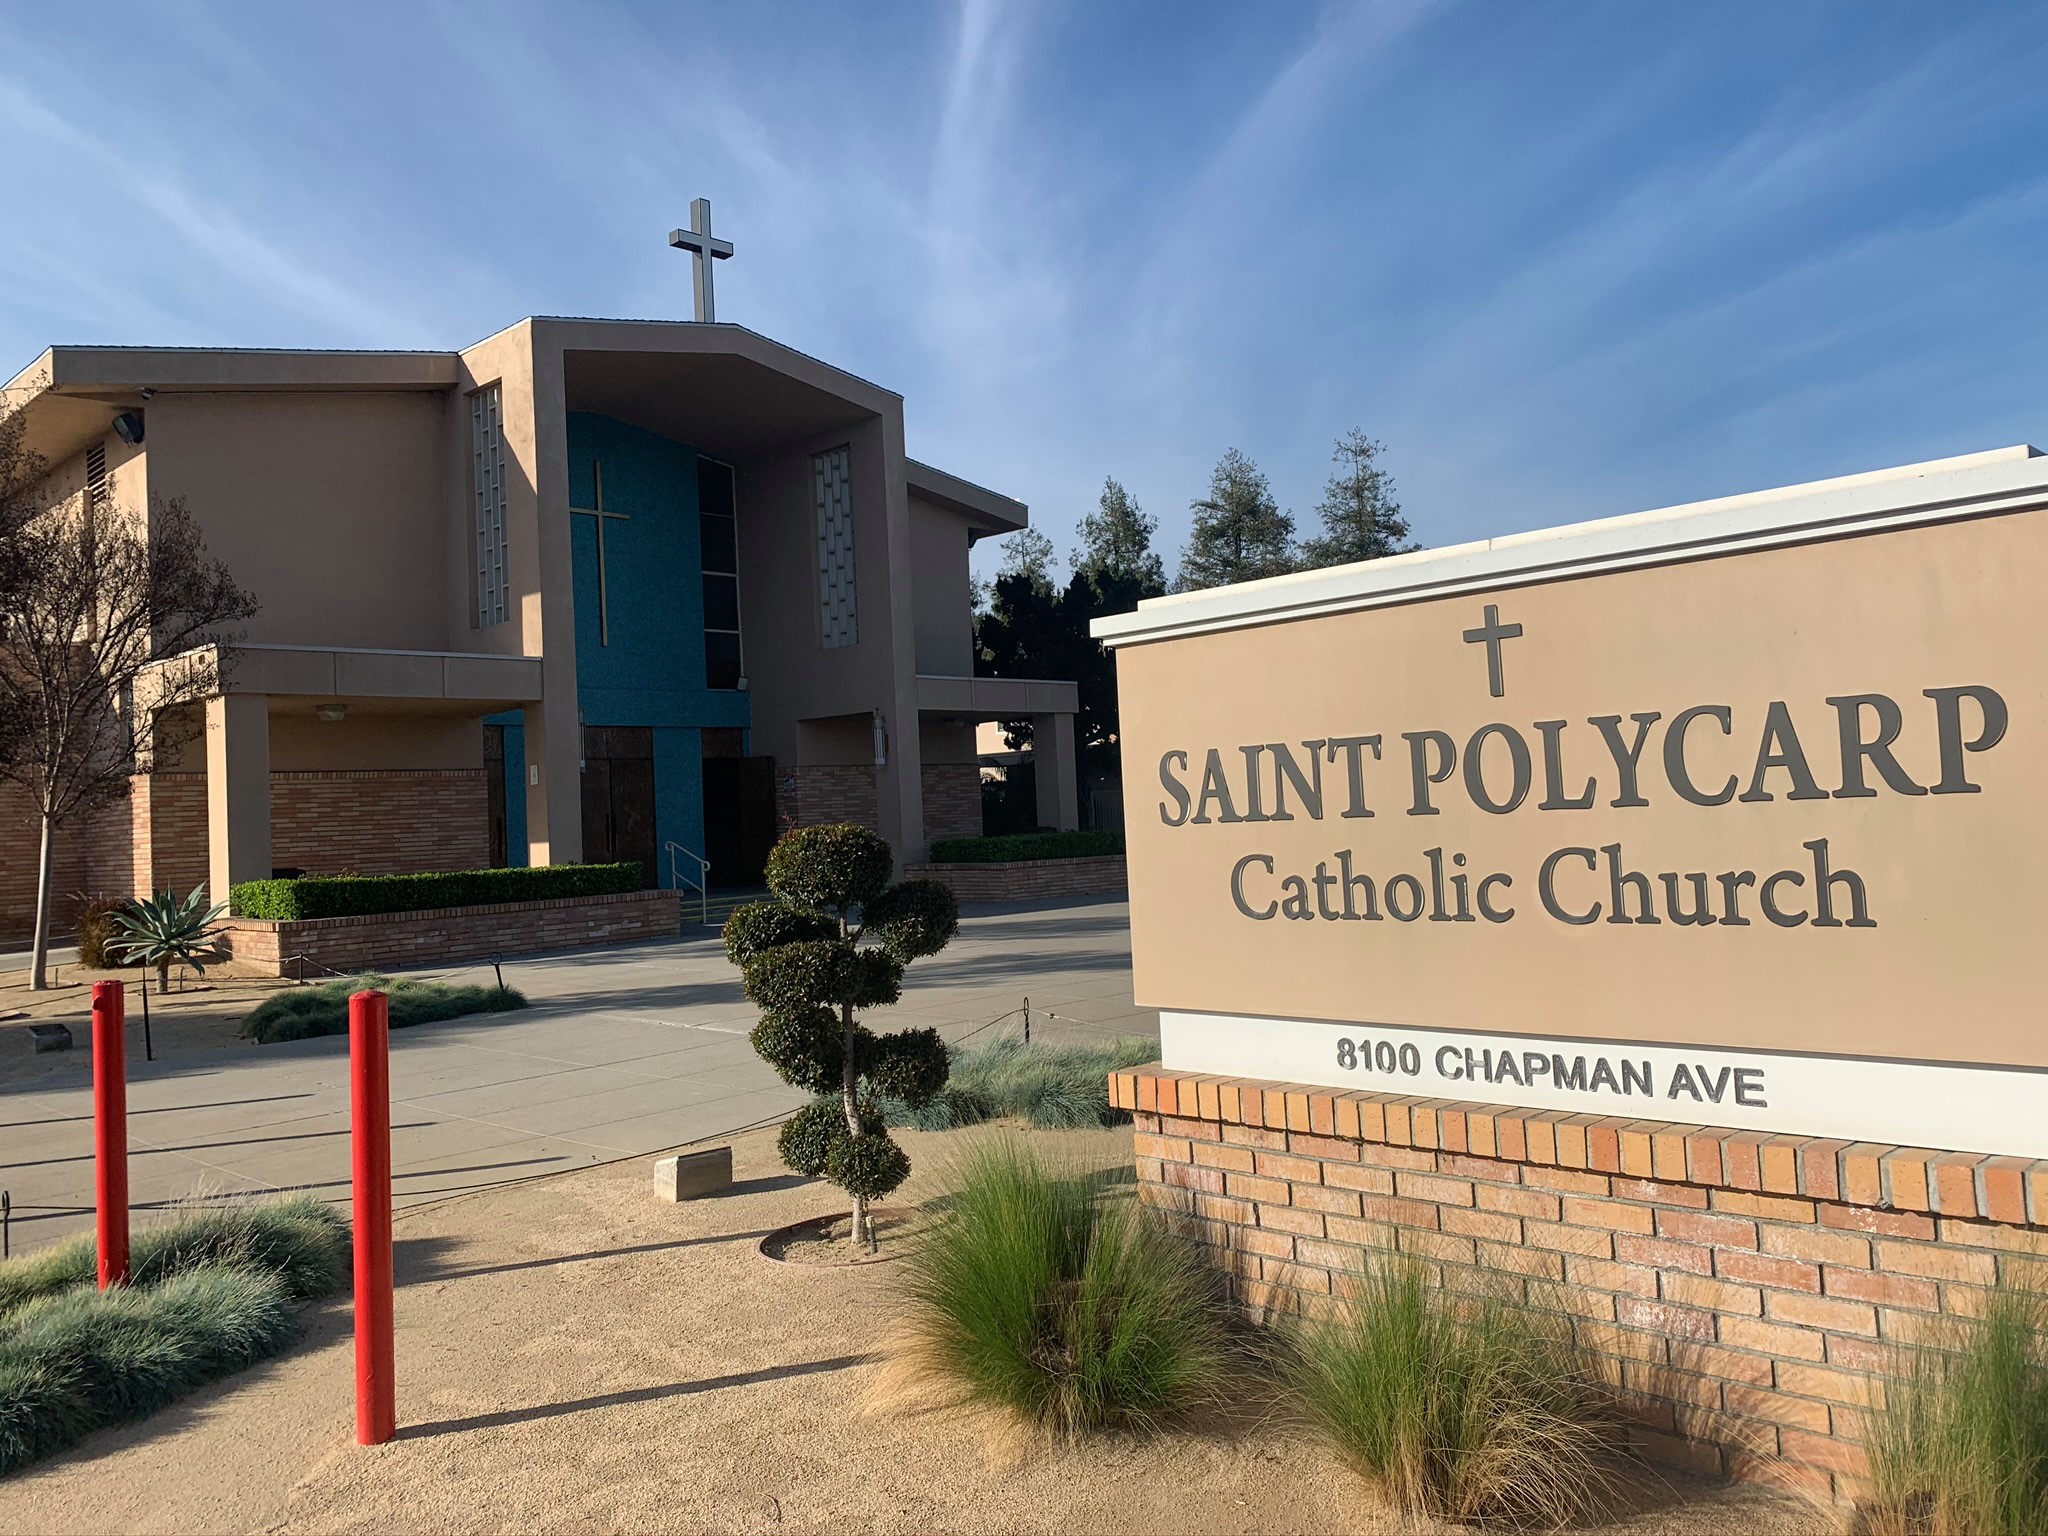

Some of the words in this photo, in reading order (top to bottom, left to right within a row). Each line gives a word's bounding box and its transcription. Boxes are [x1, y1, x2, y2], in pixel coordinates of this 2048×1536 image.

[1159, 733, 1383, 827] SAINT
[1401, 684, 2009, 817] POLYCARP
[1230, 846, 1515, 923] Catholic
[1538, 837, 1878, 928] Church
[1336, 1038, 1421, 1077] 8100
[1434, 1045, 1653, 1098] CHAPMAN
[1667, 1063, 1768, 1109] AVE
